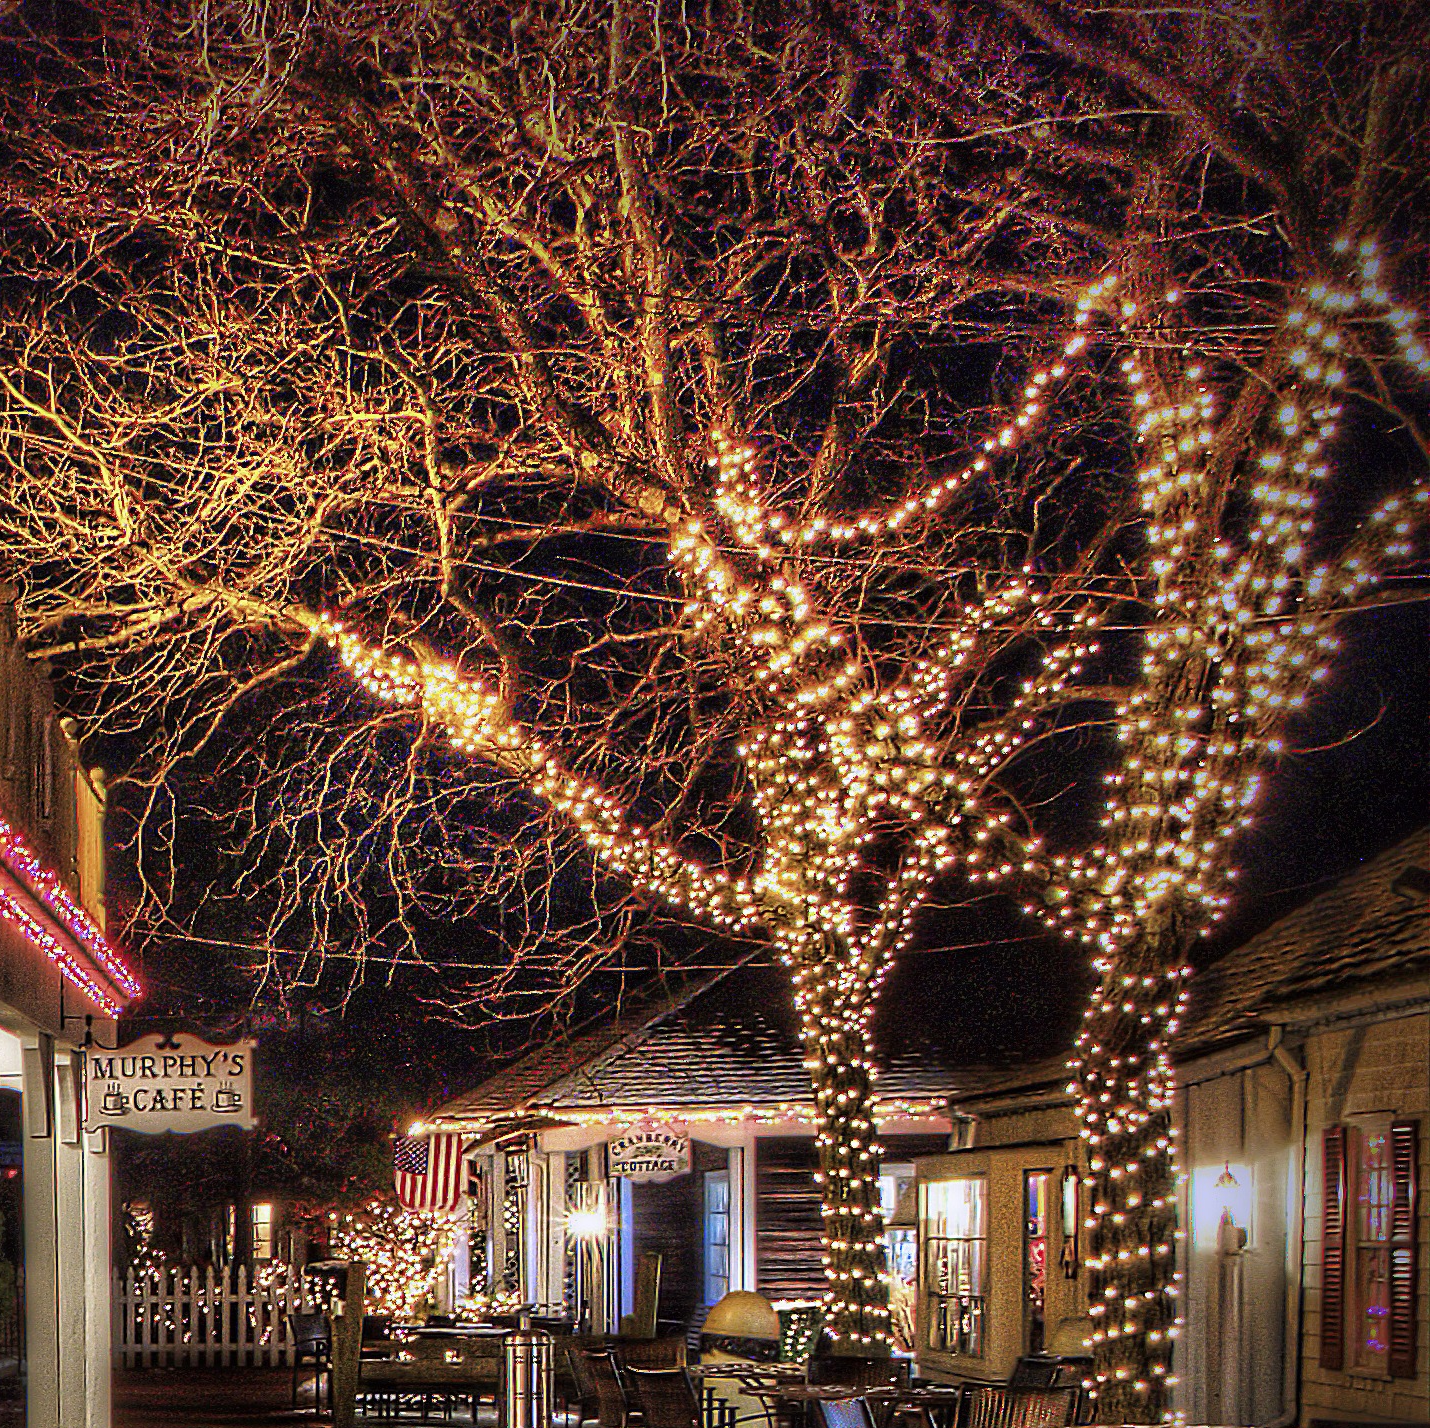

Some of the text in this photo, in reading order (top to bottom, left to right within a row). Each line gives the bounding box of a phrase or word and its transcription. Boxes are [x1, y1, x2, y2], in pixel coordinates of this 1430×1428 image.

[91, 1050, 244, 1080] MURPHY'S
[133, 1082, 205, 1112] CAFÉ
[611, 1133, 686, 1156] CRANBERRY
[619, 1159, 676, 1173] COTTAGE
